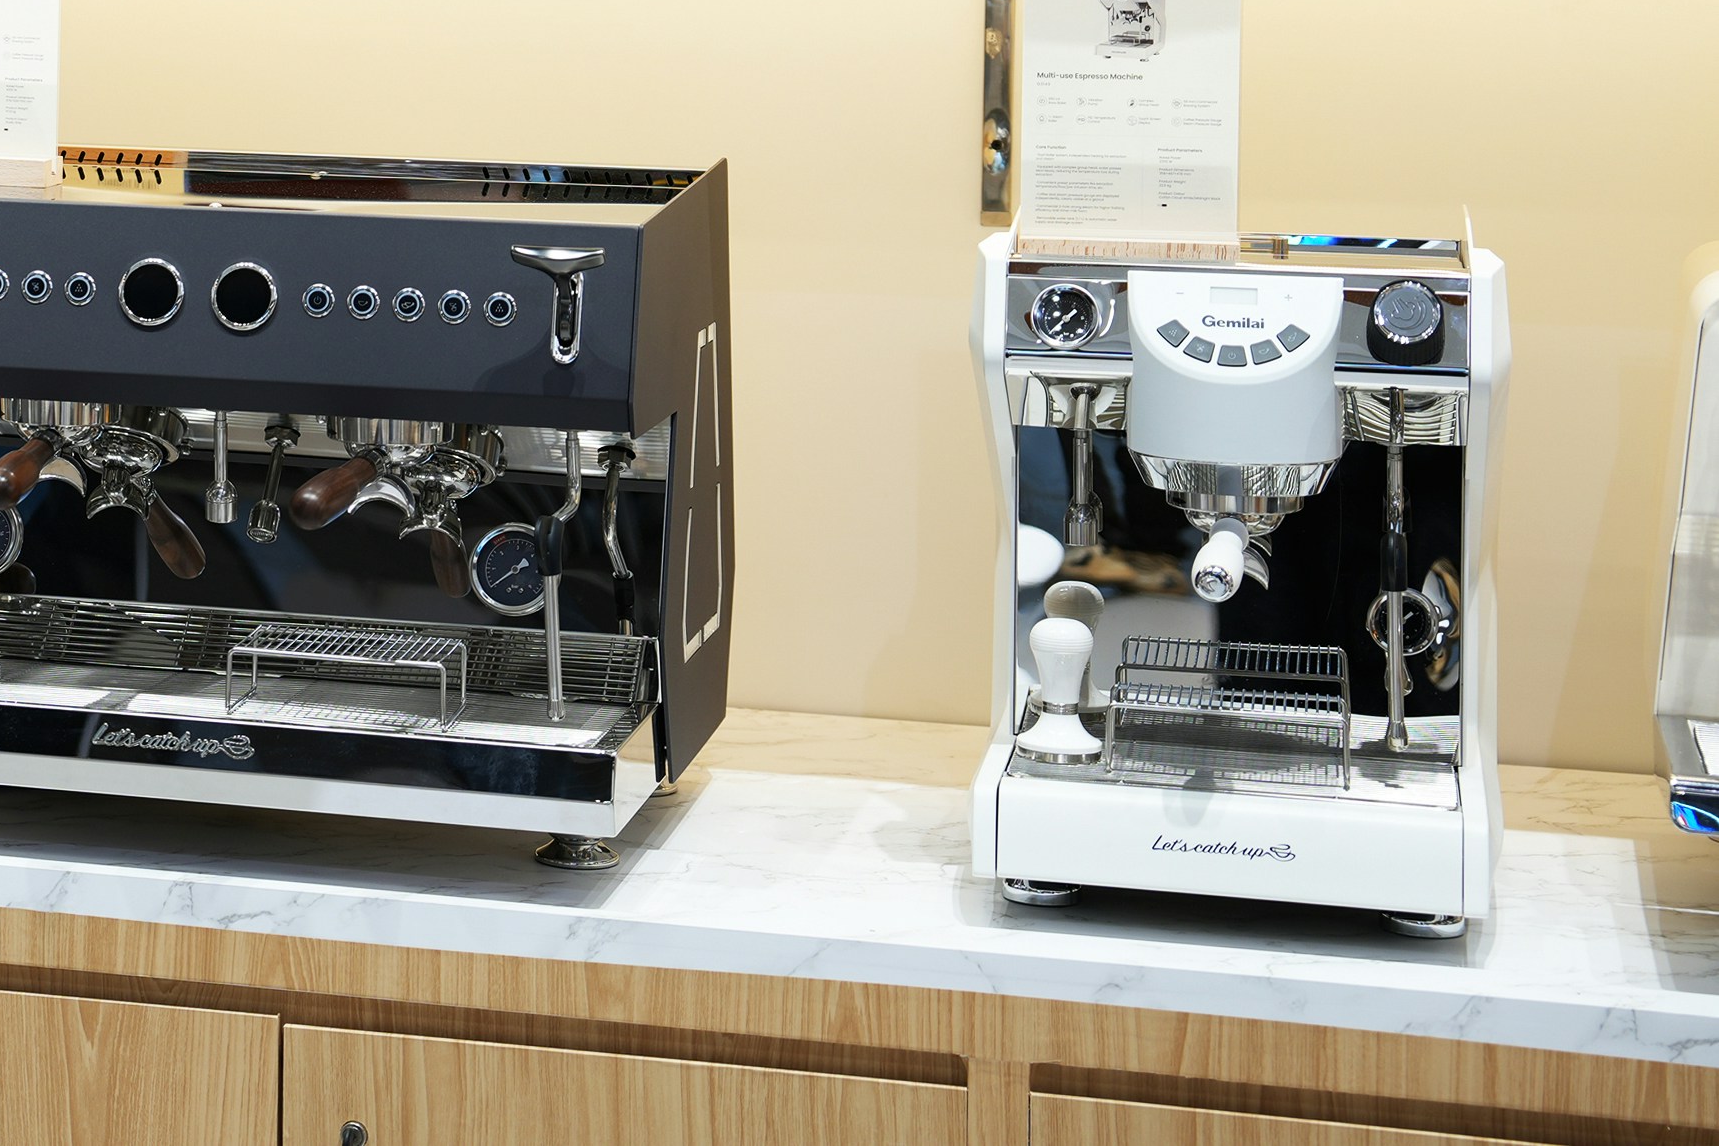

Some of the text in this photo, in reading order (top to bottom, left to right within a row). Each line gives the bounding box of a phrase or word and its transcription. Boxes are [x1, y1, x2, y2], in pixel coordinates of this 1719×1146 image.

[1074, 72, 1109, 81] Espresso
[1110, 73, 1143, 81] Machine
[1201, 315, 1265, 329] Gemilai
[91, 722, 221, 758] Let's catch up
[1151, 834, 1265, 860] Let's catch up
